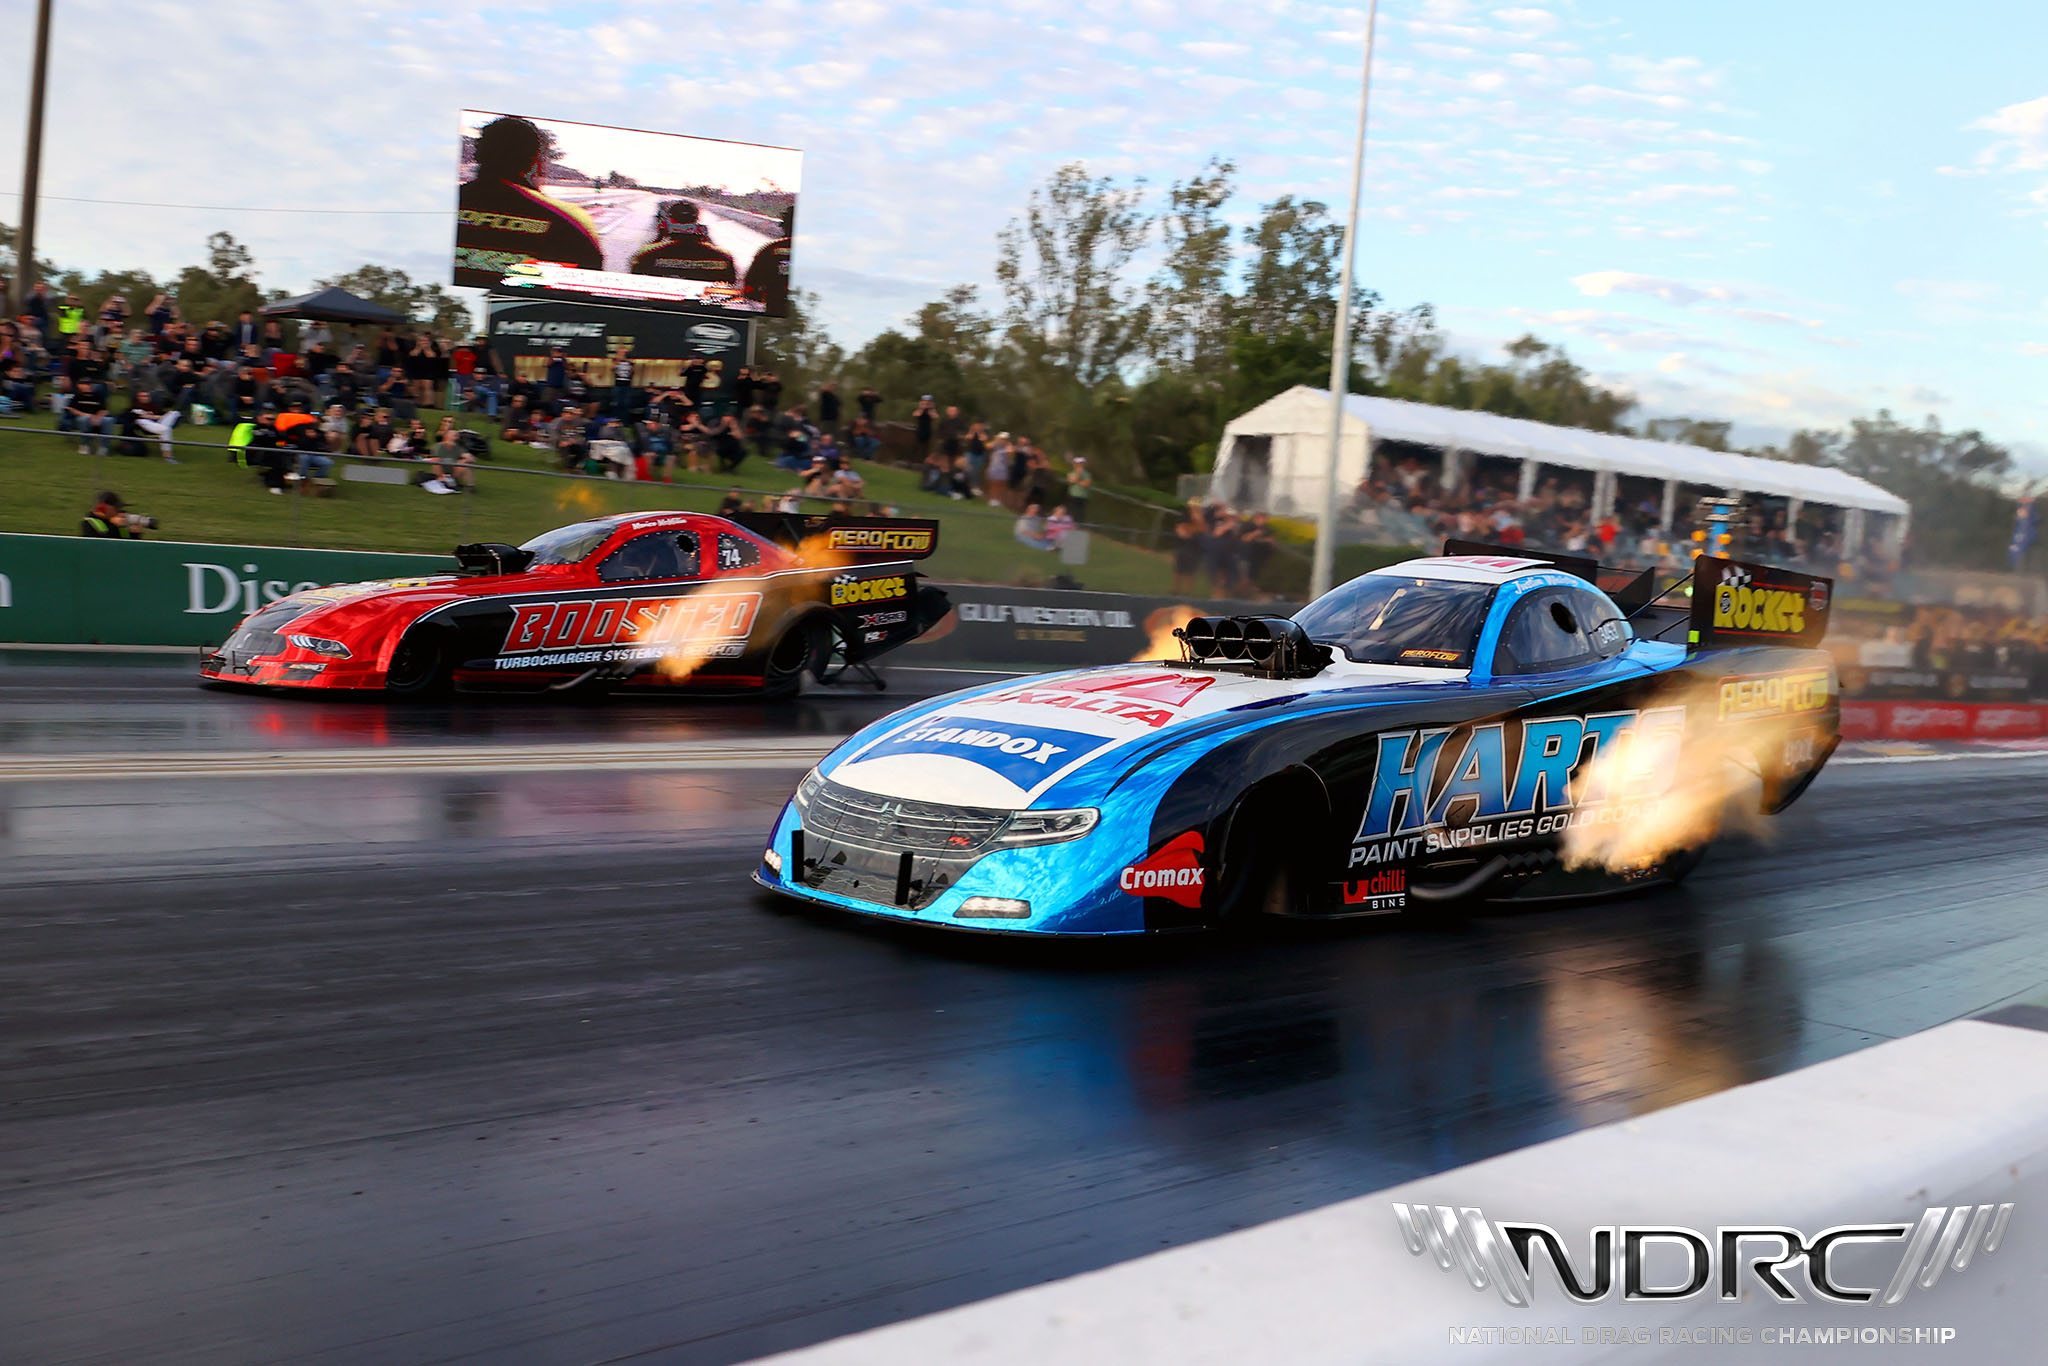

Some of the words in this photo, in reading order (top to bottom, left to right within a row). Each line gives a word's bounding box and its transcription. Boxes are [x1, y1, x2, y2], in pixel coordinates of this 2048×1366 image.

[828, 530, 932, 550] AEROFLOW
[722, 548, 742, 567] 74
[498, 592, 763, 655] BOOSTED
[494, 651, 601, 670] TURBOCHARGER
[603, 647, 664, 661] SYSTEMS
[1400, 649, 1462, 662] AEROFLOW
[894, 727, 1068, 765] STANDOX
[1348, 836, 1425, 868] PAINT
[1424, 818, 1535, 853] SUPPLIES
[1536, 809, 1595, 836] GOLD
[1120, 867, 1204, 889] Cromax
[1370, 869, 1406, 893] chilli
[1372, 897, 1406, 909] BINS
